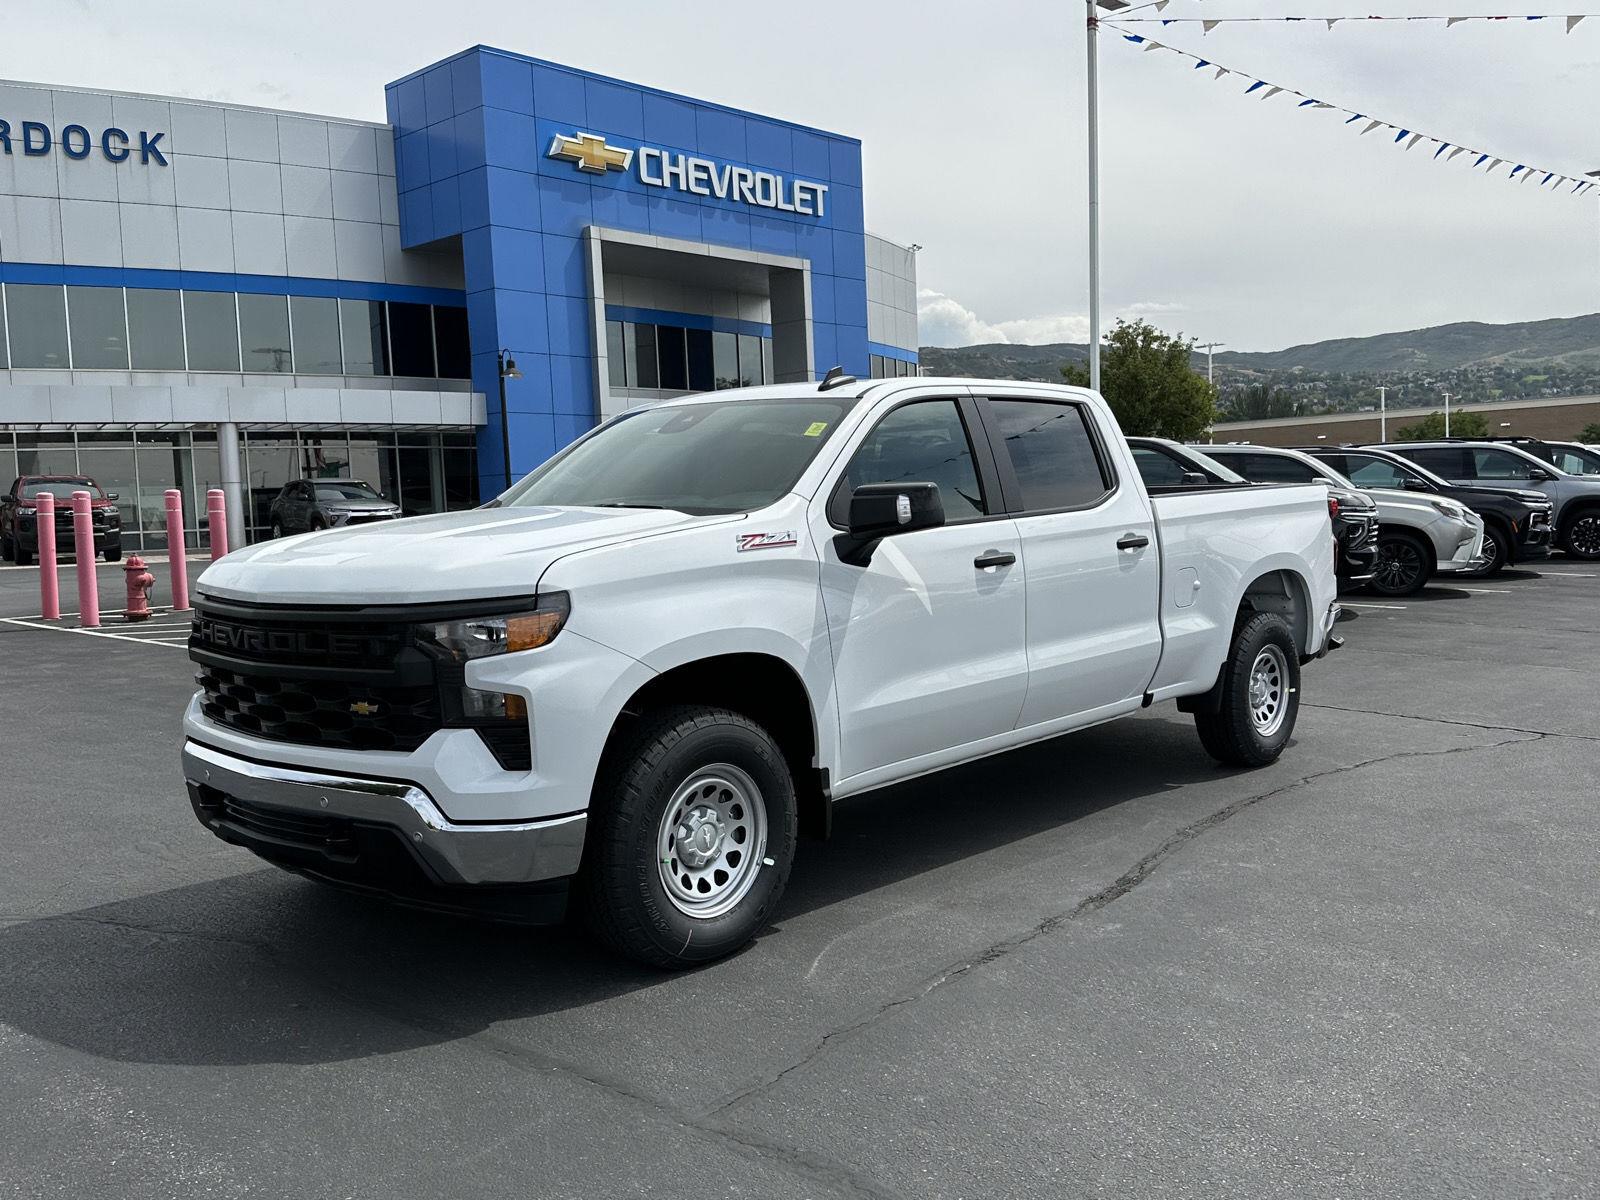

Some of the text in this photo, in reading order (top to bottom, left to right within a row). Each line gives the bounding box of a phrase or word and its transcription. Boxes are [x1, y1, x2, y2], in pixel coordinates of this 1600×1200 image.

[638, 146, 829, 217] CHEVROLET
[736, 531, 798, 553] Z71
[191, 618, 395, 656] CHEVROLET
